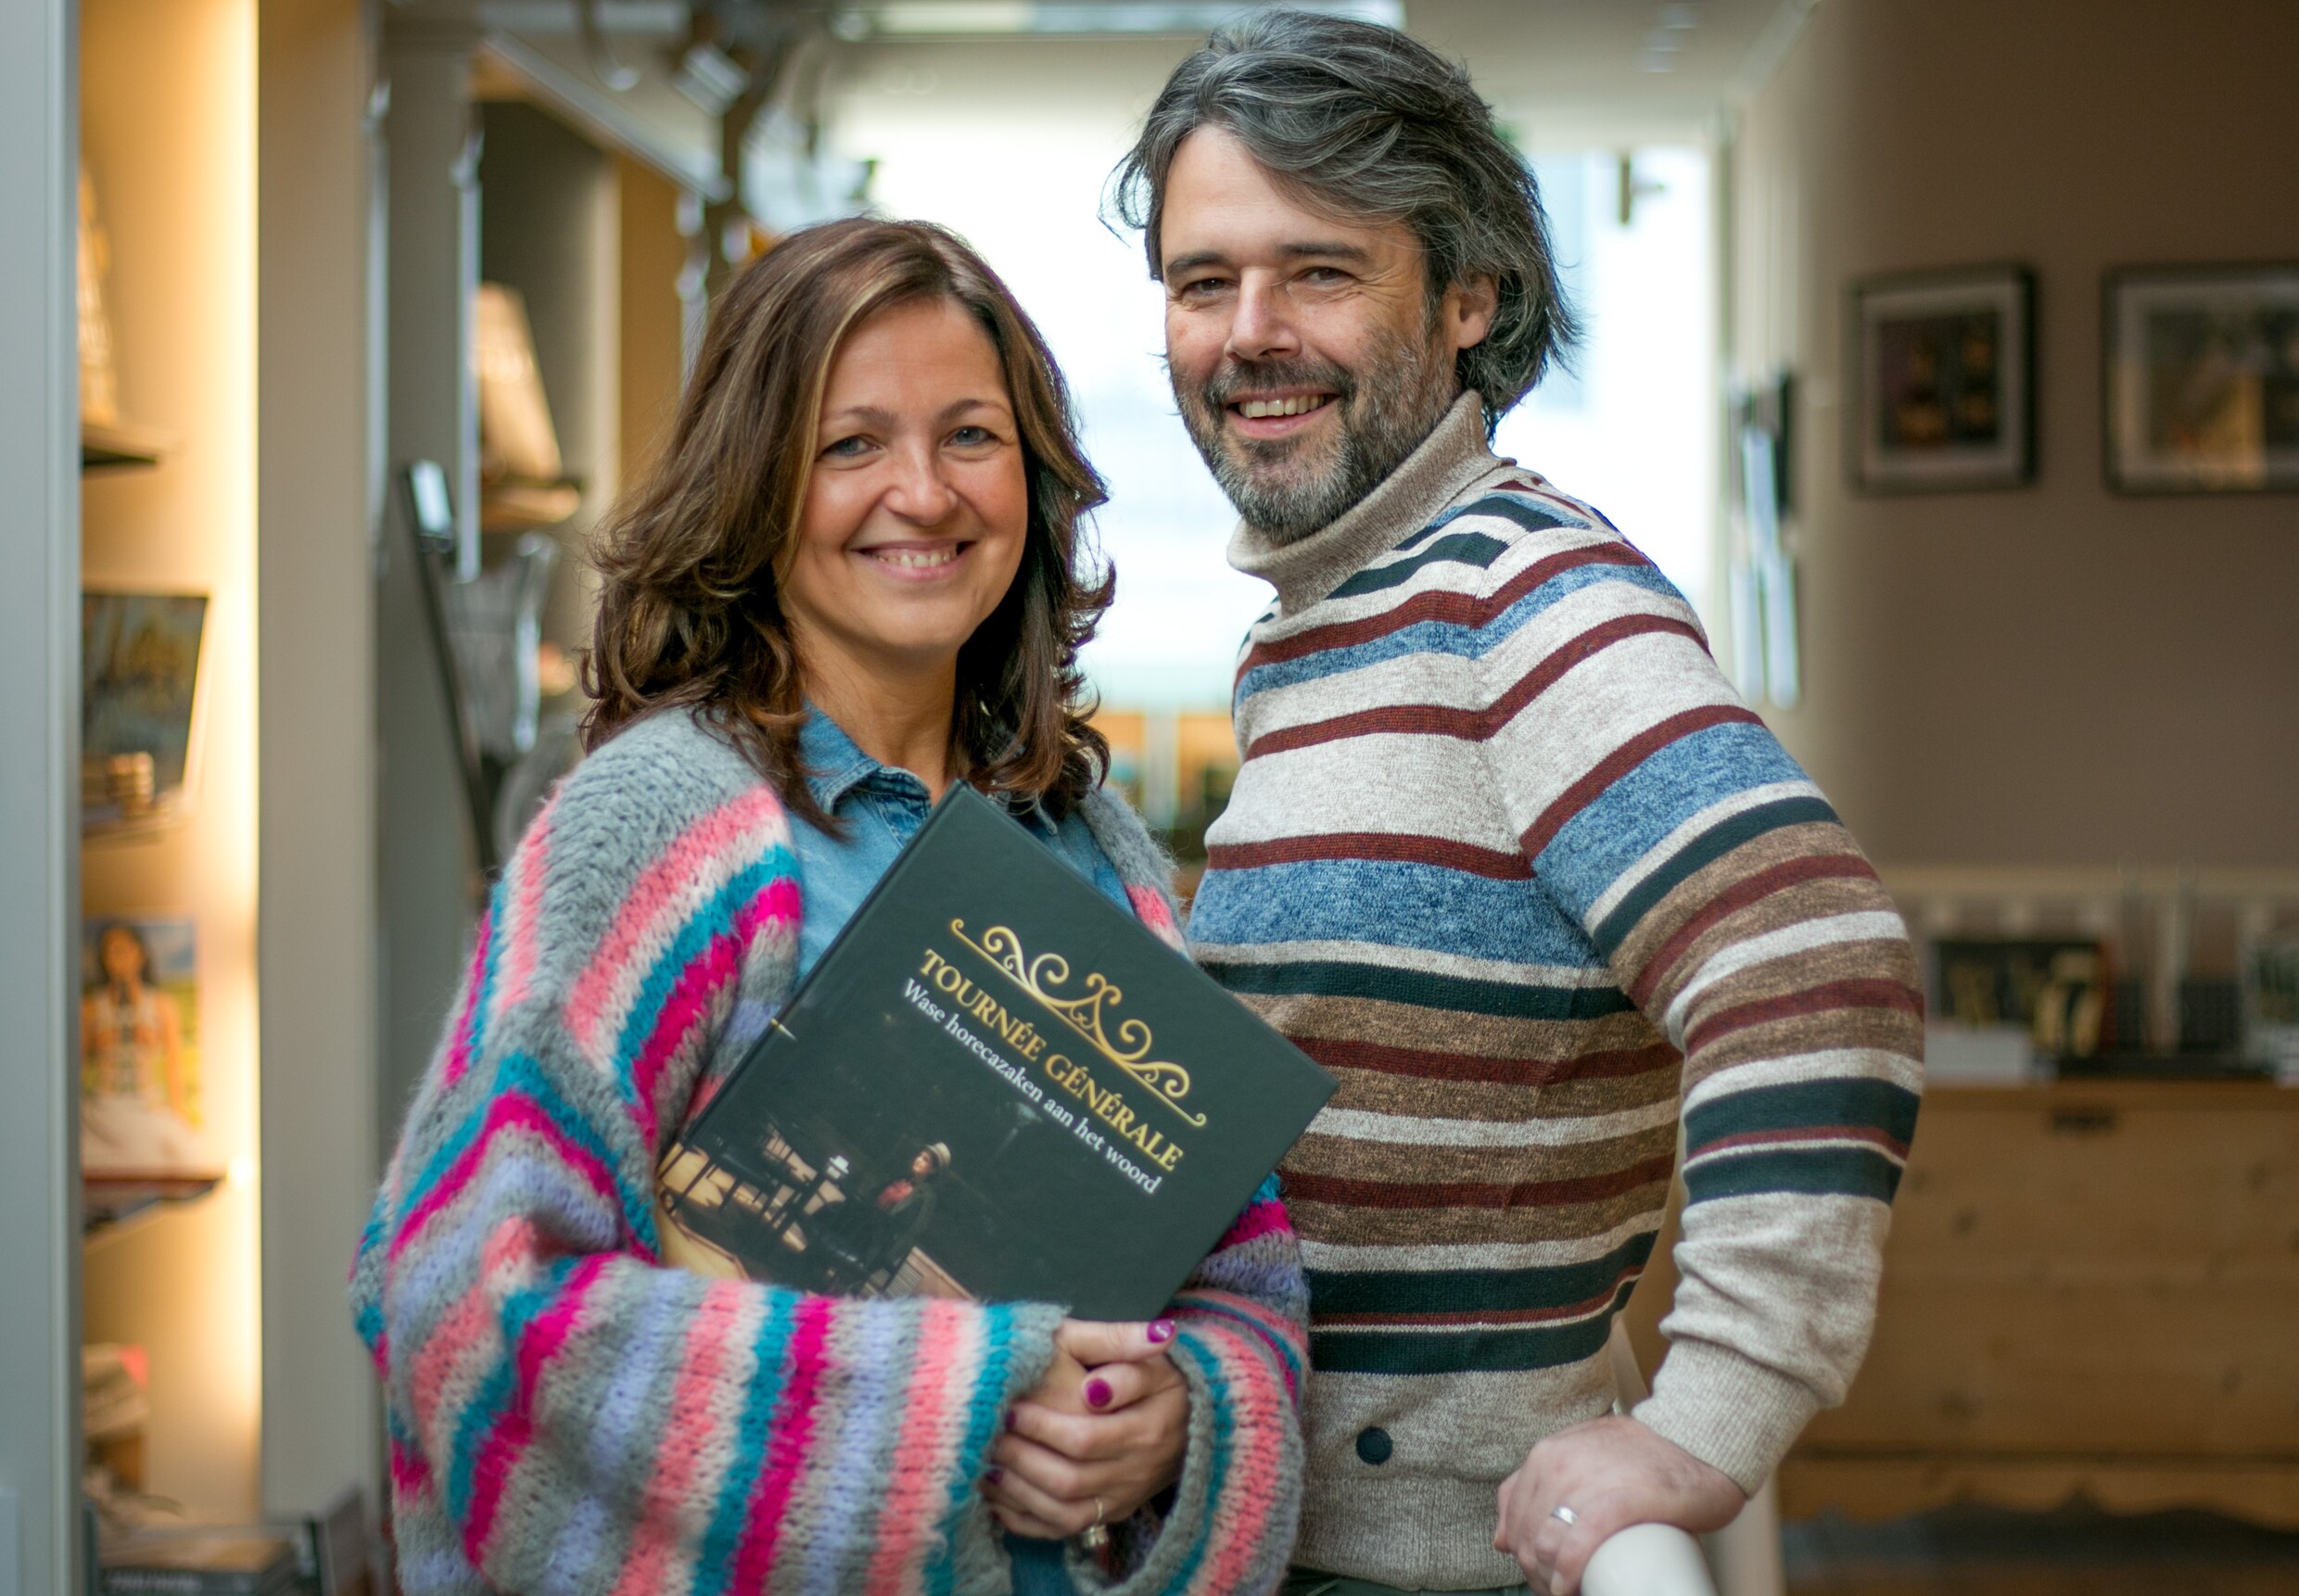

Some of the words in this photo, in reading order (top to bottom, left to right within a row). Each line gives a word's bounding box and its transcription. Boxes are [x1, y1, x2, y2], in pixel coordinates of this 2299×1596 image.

[904, 978, 946, 1023] Wase
[946, 1013, 1043, 1103] horecazaken
[1044, 1098, 1074, 1127] aan
[1074, 1116, 1106, 1151] het
[1105, 1146, 1162, 1195] woord
[921, 949, 1047, 1062] TOURNÉE
[1045, 1054, 1184, 1172] GÉNÉRALE
